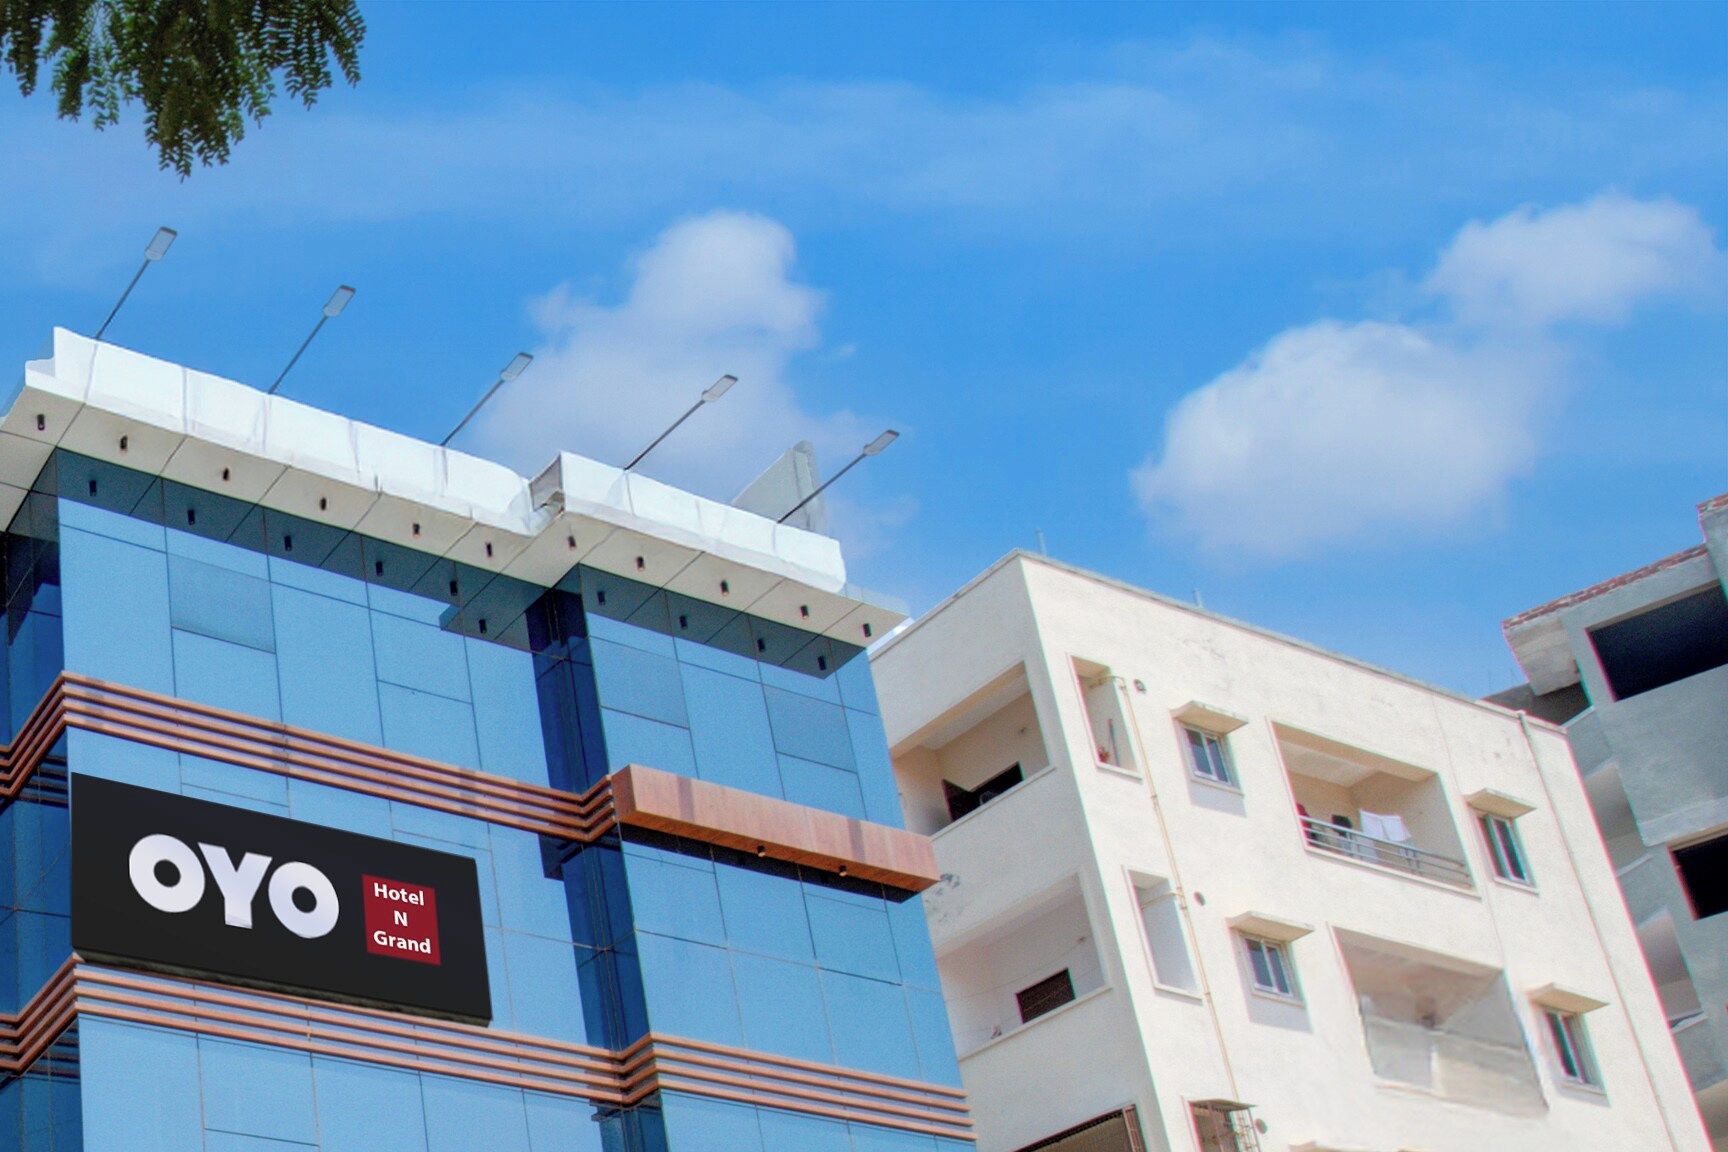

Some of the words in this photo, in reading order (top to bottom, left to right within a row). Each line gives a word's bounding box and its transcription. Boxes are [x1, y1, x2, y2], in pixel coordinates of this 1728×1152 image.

[129, 834, 340, 939] OYO
[373, 882, 425, 906] Hotel
[393, 910, 408, 927] N
[373, 930, 432, 954] Grand
